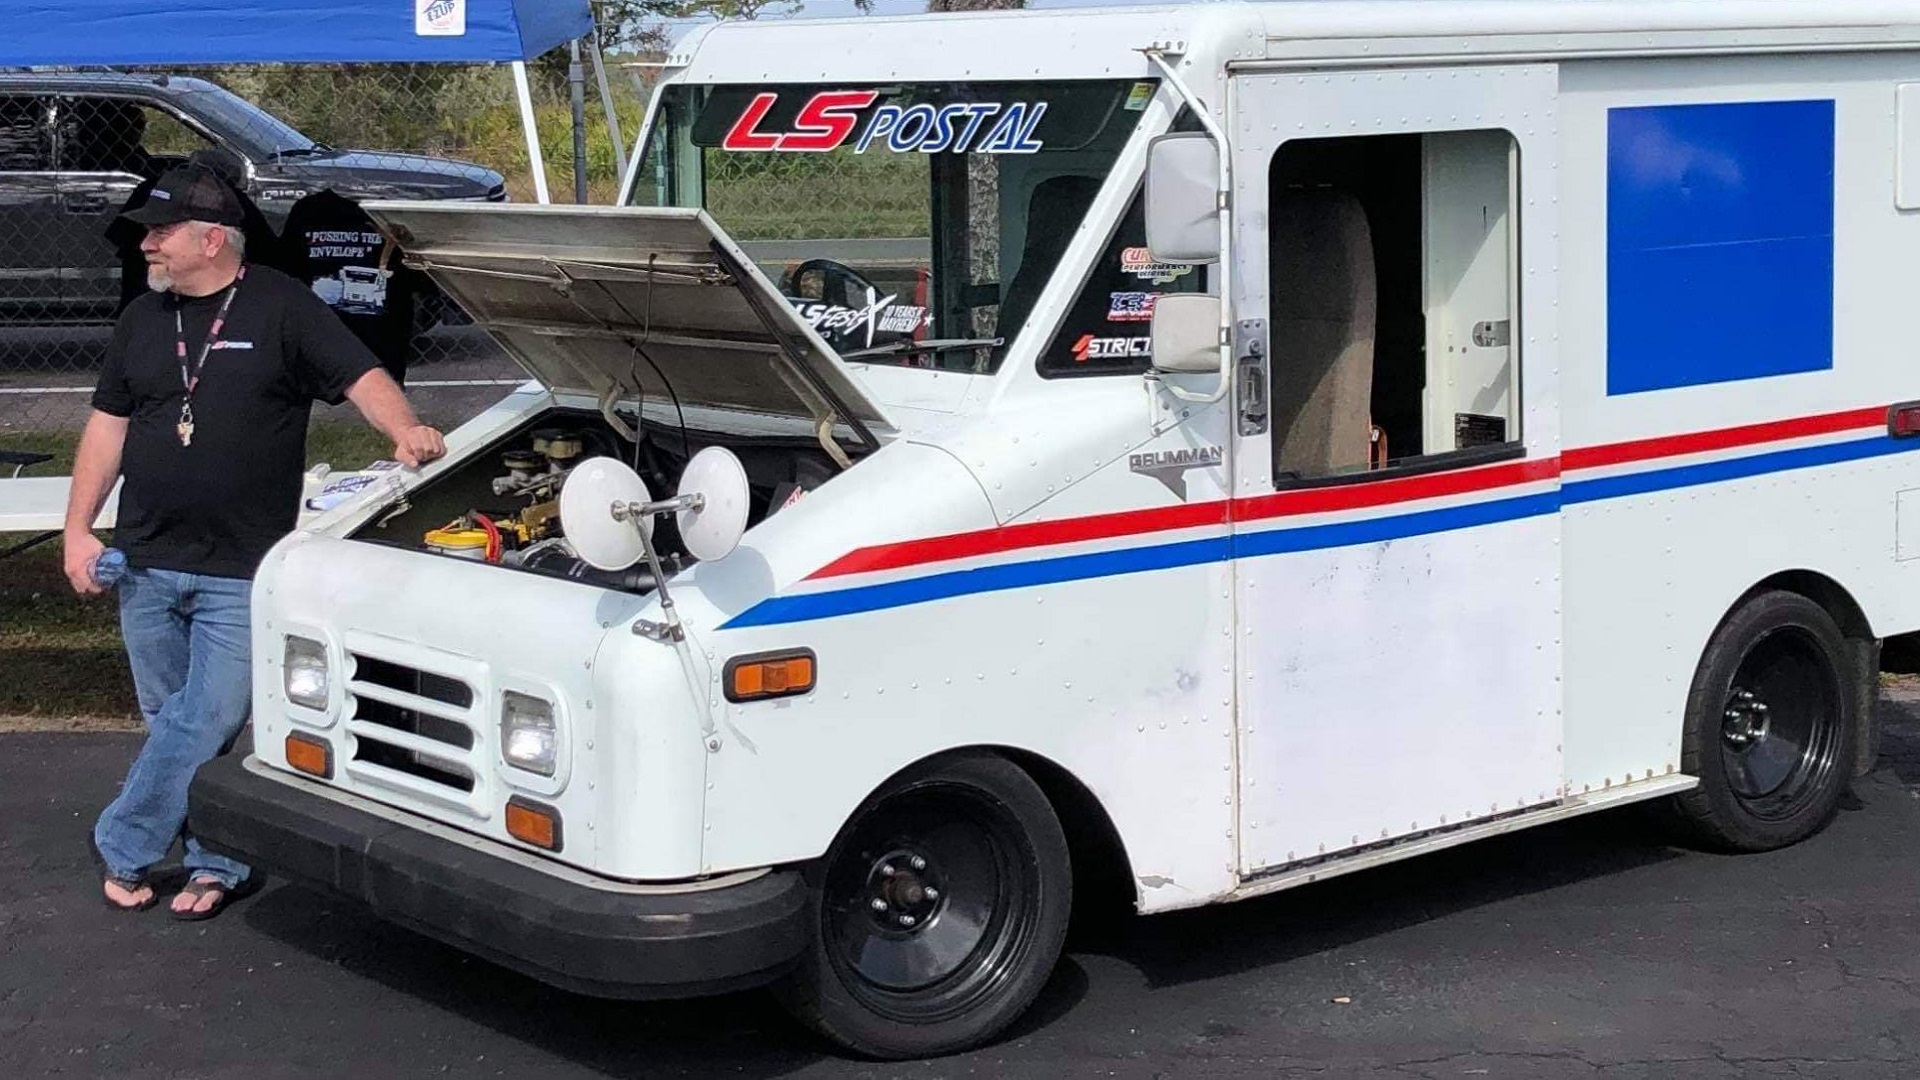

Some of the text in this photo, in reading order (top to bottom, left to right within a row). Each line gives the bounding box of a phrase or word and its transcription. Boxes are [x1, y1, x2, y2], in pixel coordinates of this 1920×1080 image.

[722, 90, 1048, 154] LS POSTAL
[361, 232, 382, 244] THE
[1129, 445, 1222, 467] GRUMMAN
